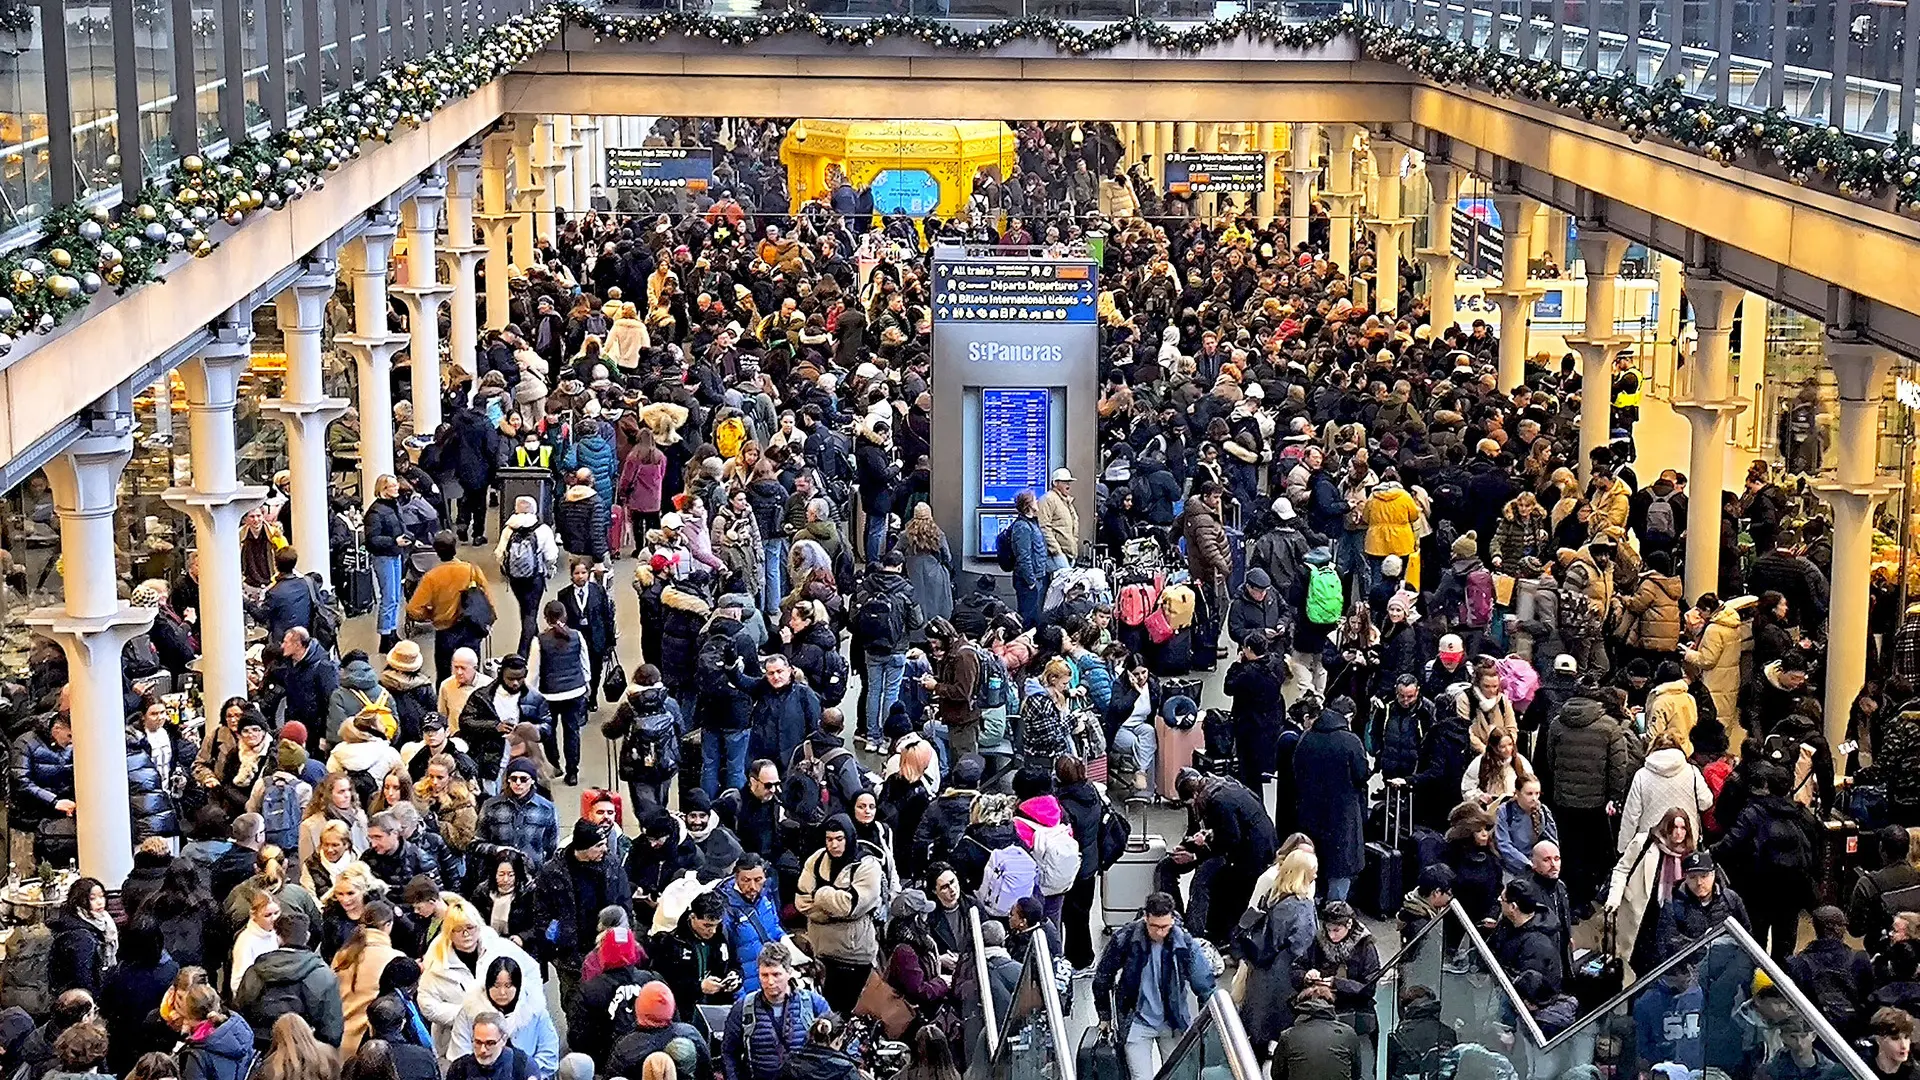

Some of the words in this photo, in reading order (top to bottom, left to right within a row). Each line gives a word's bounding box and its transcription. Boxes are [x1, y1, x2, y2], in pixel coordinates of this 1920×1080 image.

[952, 265, 966, 276] All
[967, 265, 995, 276] trains
[991, 281, 1027, 292] Départs
[1028, 281, 1079, 292] Departures
[959, 294, 989, 305] Billets
[989, 294, 1048, 305] International
[1048, 294, 1079, 305] tickets
